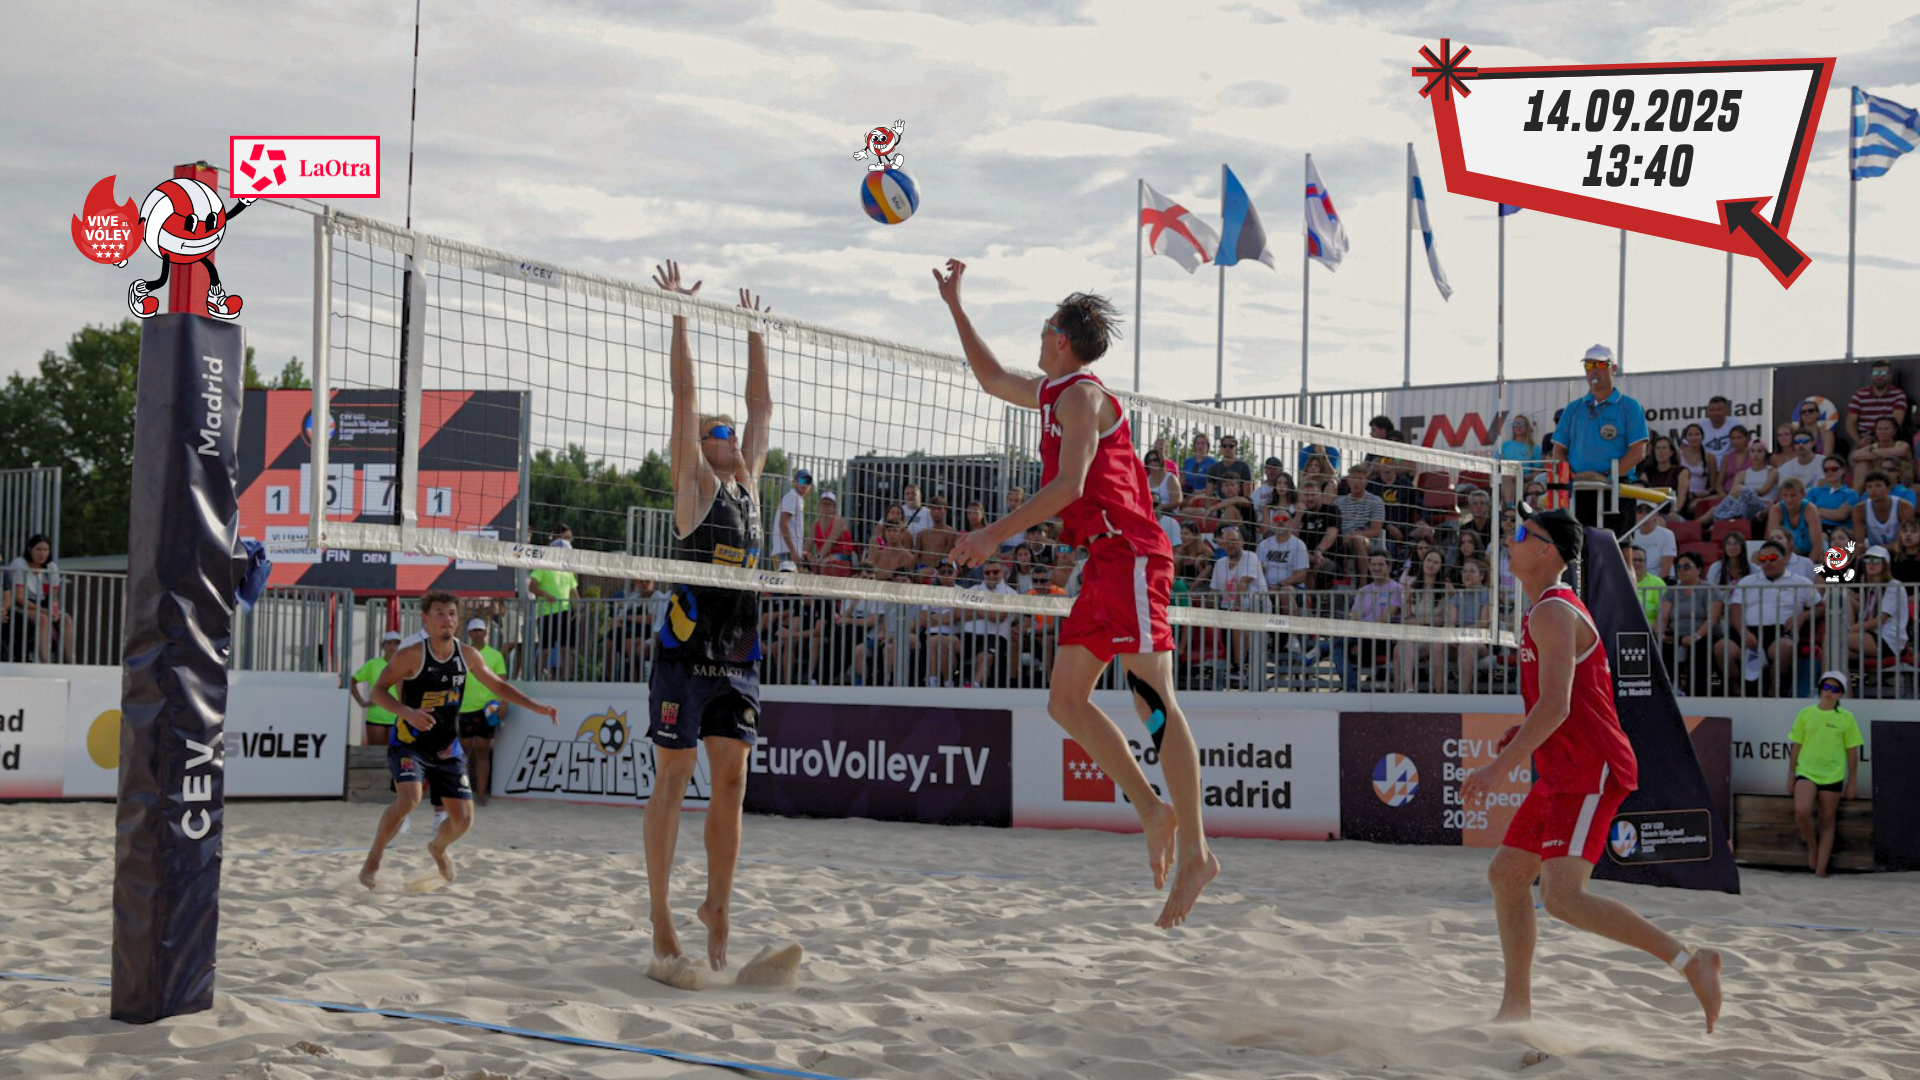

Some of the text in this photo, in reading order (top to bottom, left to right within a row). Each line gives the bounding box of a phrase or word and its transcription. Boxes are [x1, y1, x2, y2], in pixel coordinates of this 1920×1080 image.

[532, 266, 553, 280] CEV
[198, 355, 223, 457] Madrid
[272, 489, 281, 511] 1
[379, 475, 397, 507] 7
[433, 491, 443, 513] 1
[326, 549, 350, 562] FIN
[362, 553, 387, 563] DEN
[525, 548, 546, 560] CEV
[769, 576, 786, 586] CEV
[970, 594, 985, 604] CEV
[1442, 738, 1483, 758] CEV
[750, 736, 990, 793] EuroVolley.TV
[181, 738, 215, 840] CEV
[1200, 780, 1292, 810] adrid
[1442, 808, 1489, 830] 2025
